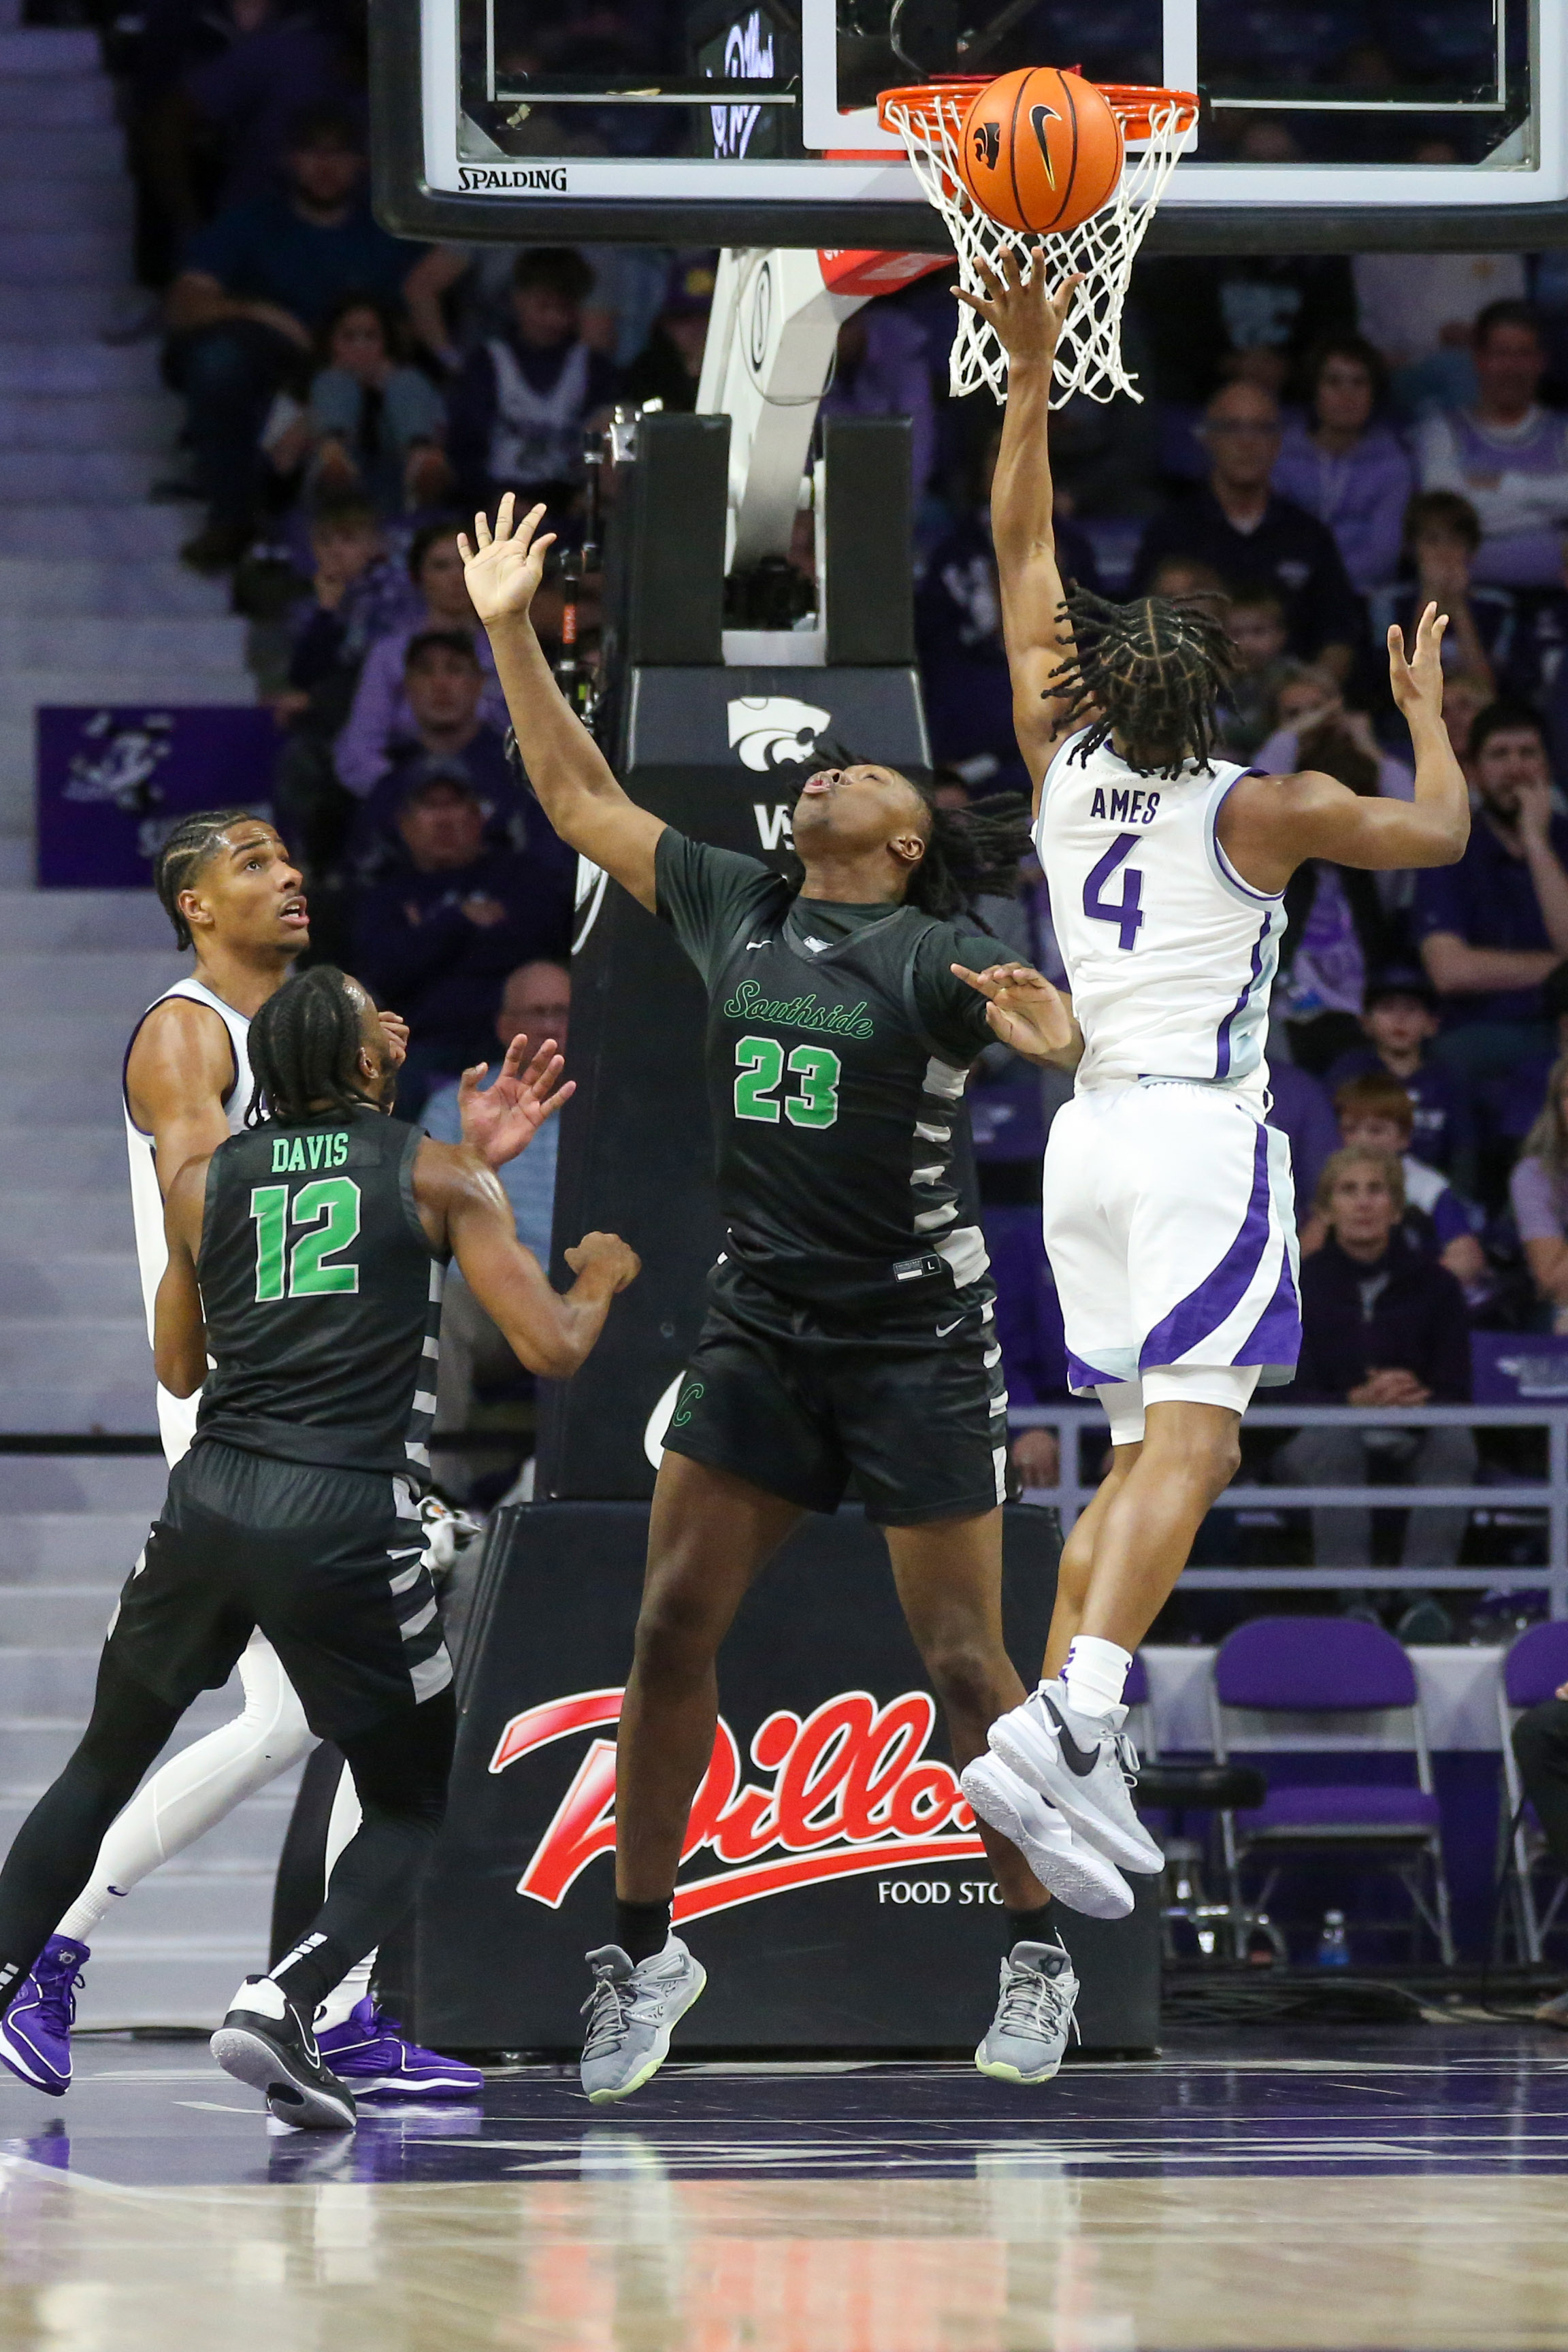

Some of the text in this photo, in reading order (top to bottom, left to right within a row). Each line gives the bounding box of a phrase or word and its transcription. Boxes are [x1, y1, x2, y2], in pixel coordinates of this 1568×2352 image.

[458, 167, 566, 191] SPALDING
[1090, 787, 1160, 824] AMES
[1082, 832, 1145, 952] 4
[724, 979, 873, 1039] Southside
[734, 1035, 841, 1129] 23
[271, 1132, 348, 1173] DAVIS
[249, 1176, 361, 1303] 12
[488, 1687, 976, 1910] Dillo
[878, 1881, 1004, 1904] FOOD STO
